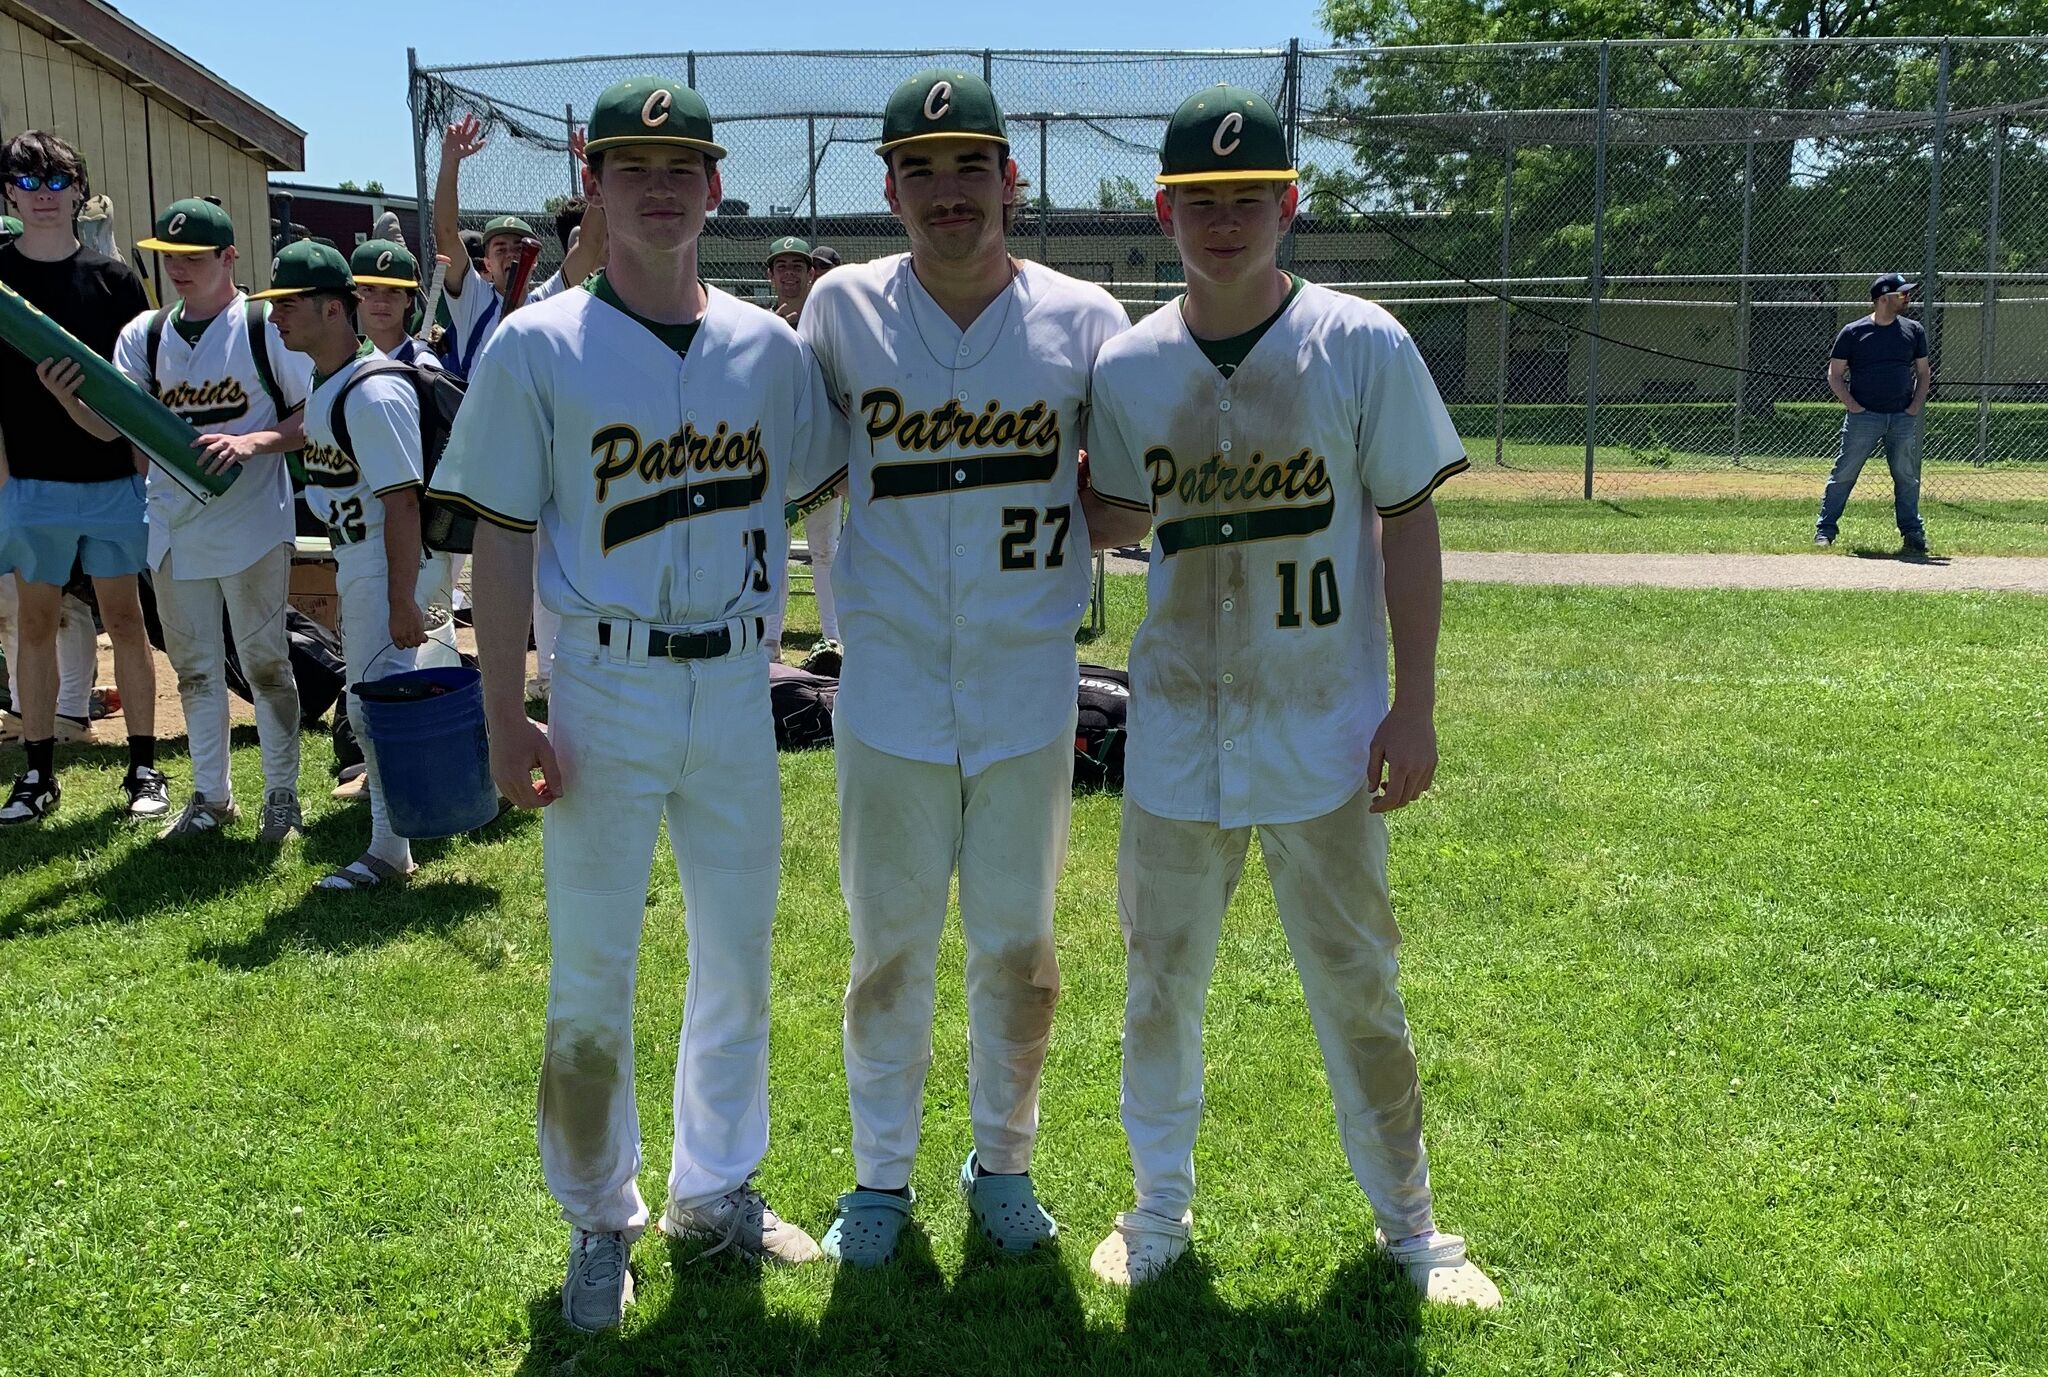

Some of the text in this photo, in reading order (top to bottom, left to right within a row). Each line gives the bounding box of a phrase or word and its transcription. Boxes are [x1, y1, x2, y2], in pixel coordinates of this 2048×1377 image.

[641, 88, 673, 128] C
[923, 80, 952, 121] C
[1211, 112, 1243, 156] C
[168, 212, 187, 235] C
[783, 238, 794, 249] C
[270, 256, 281, 282] C
[376, 250, 393, 272] C
[156, 376, 243, 409] atriots
[861, 386, 1060, 458] Patriots
[1144, 444, 1328, 516] Patriots
[1000, 503, 1071, 572] 27
[1275, 556, 1342, 630] 10
